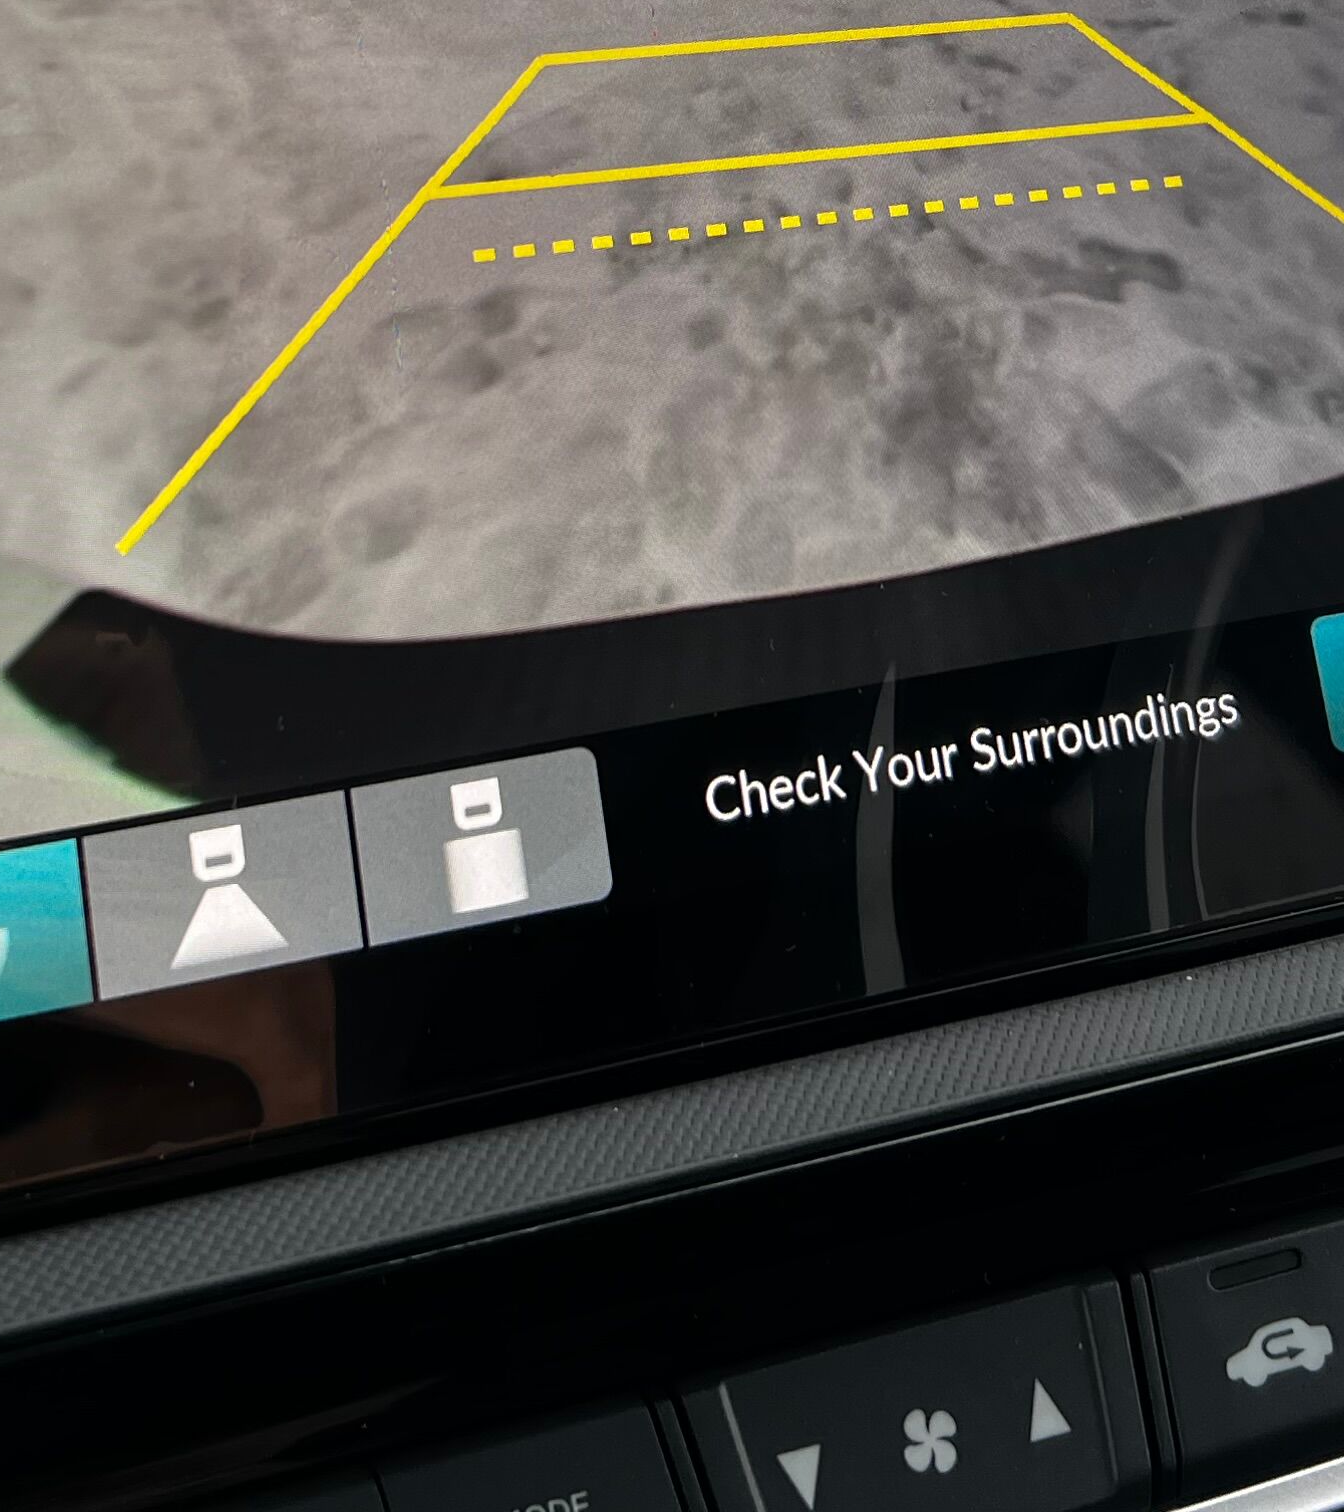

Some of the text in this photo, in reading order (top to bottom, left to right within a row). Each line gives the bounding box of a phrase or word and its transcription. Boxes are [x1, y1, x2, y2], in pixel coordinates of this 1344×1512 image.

[704, 692, 1240, 822] Check Your Surroundings
